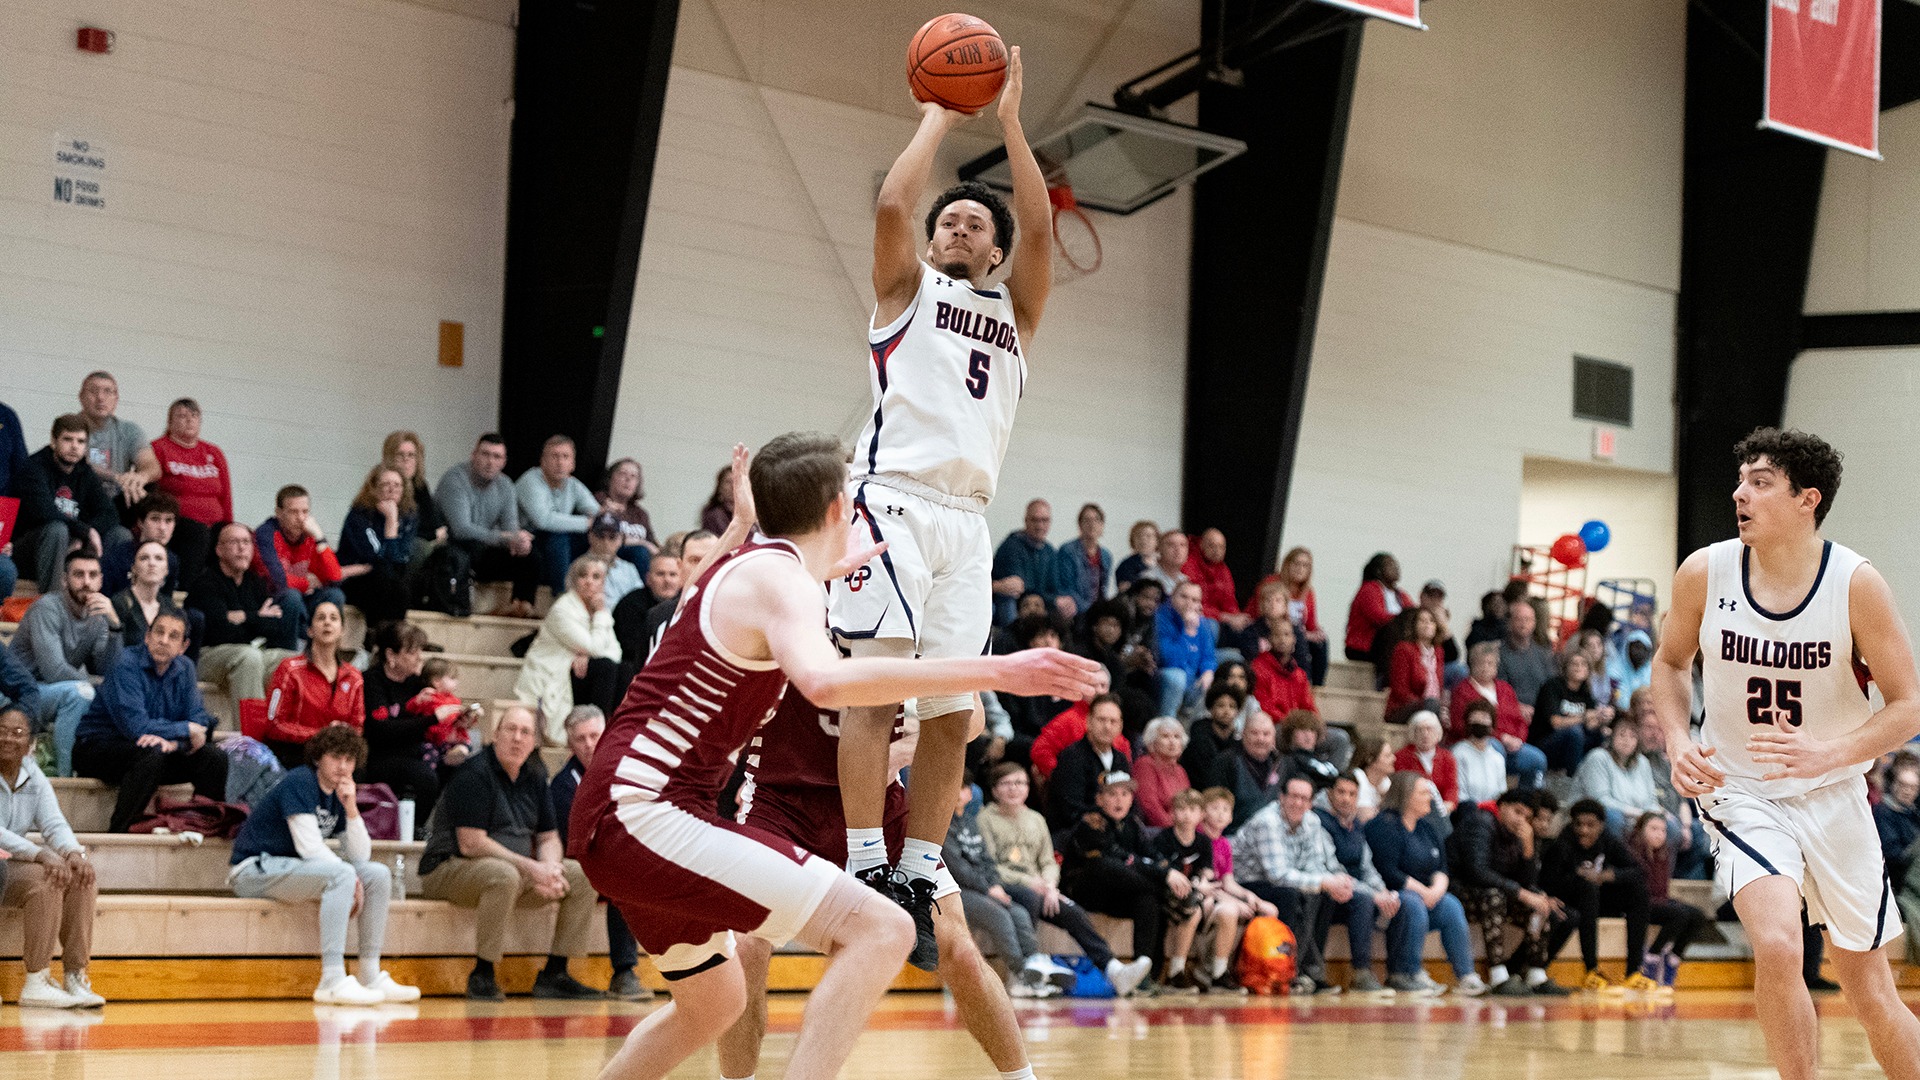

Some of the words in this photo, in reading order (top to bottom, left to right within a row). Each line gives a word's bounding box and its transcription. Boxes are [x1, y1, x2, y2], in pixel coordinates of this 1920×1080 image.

[943, 43, 982, 65] ROCK
[56, 150, 105, 169] SMOKING
[72, 140, 88, 153] NO
[54, 176, 72, 203] NO
[965, 348, 991, 400] 5
[1721, 629, 1831, 670] BULLDOGS
[1746, 676, 1803, 728] 25
